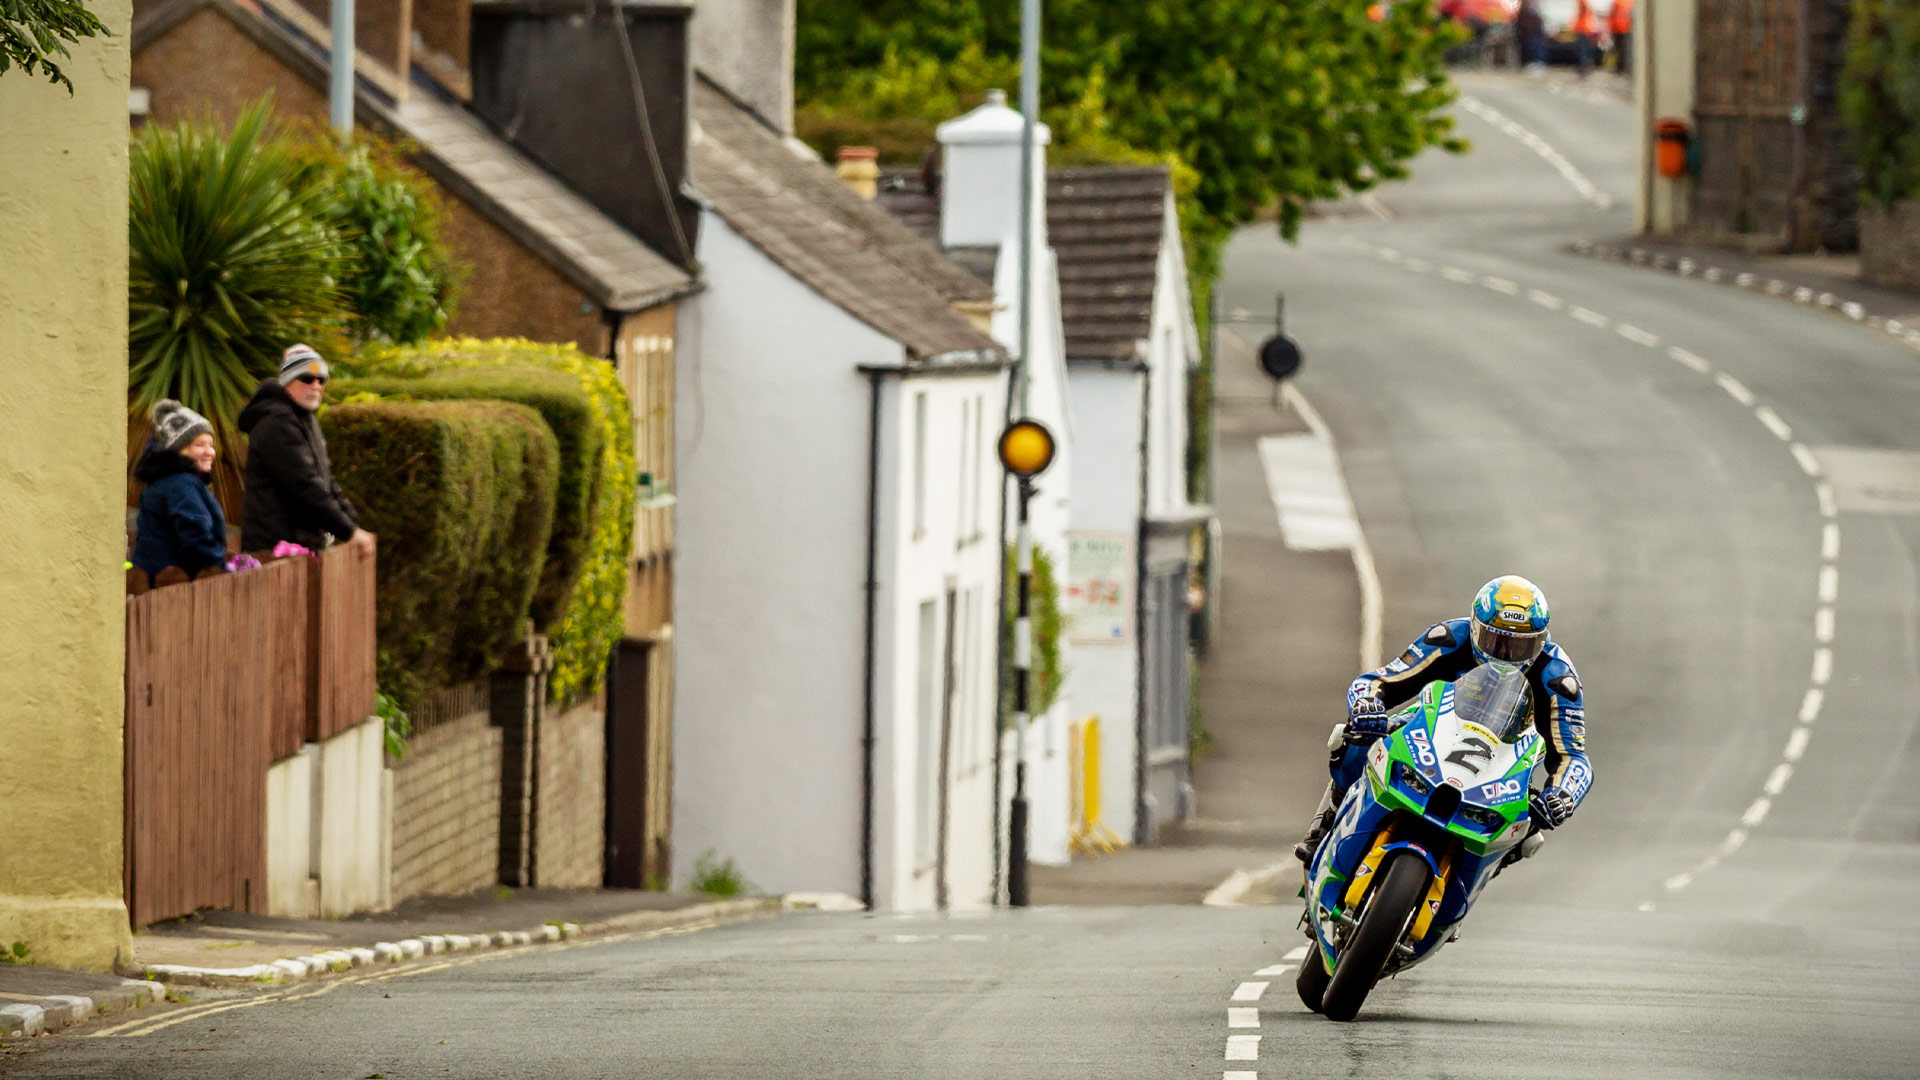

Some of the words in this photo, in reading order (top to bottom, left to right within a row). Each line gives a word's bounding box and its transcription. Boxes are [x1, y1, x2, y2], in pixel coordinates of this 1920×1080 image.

[1503, 611, 1525, 621] SHOEI
[1404, 734, 1419, 764] RACING
[1409, 728, 1436, 766] DAO
[1444, 737, 1493, 775] 2
[1481, 779, 1521, 800] DAO
[1491, 795, 1521, 805] RACING
